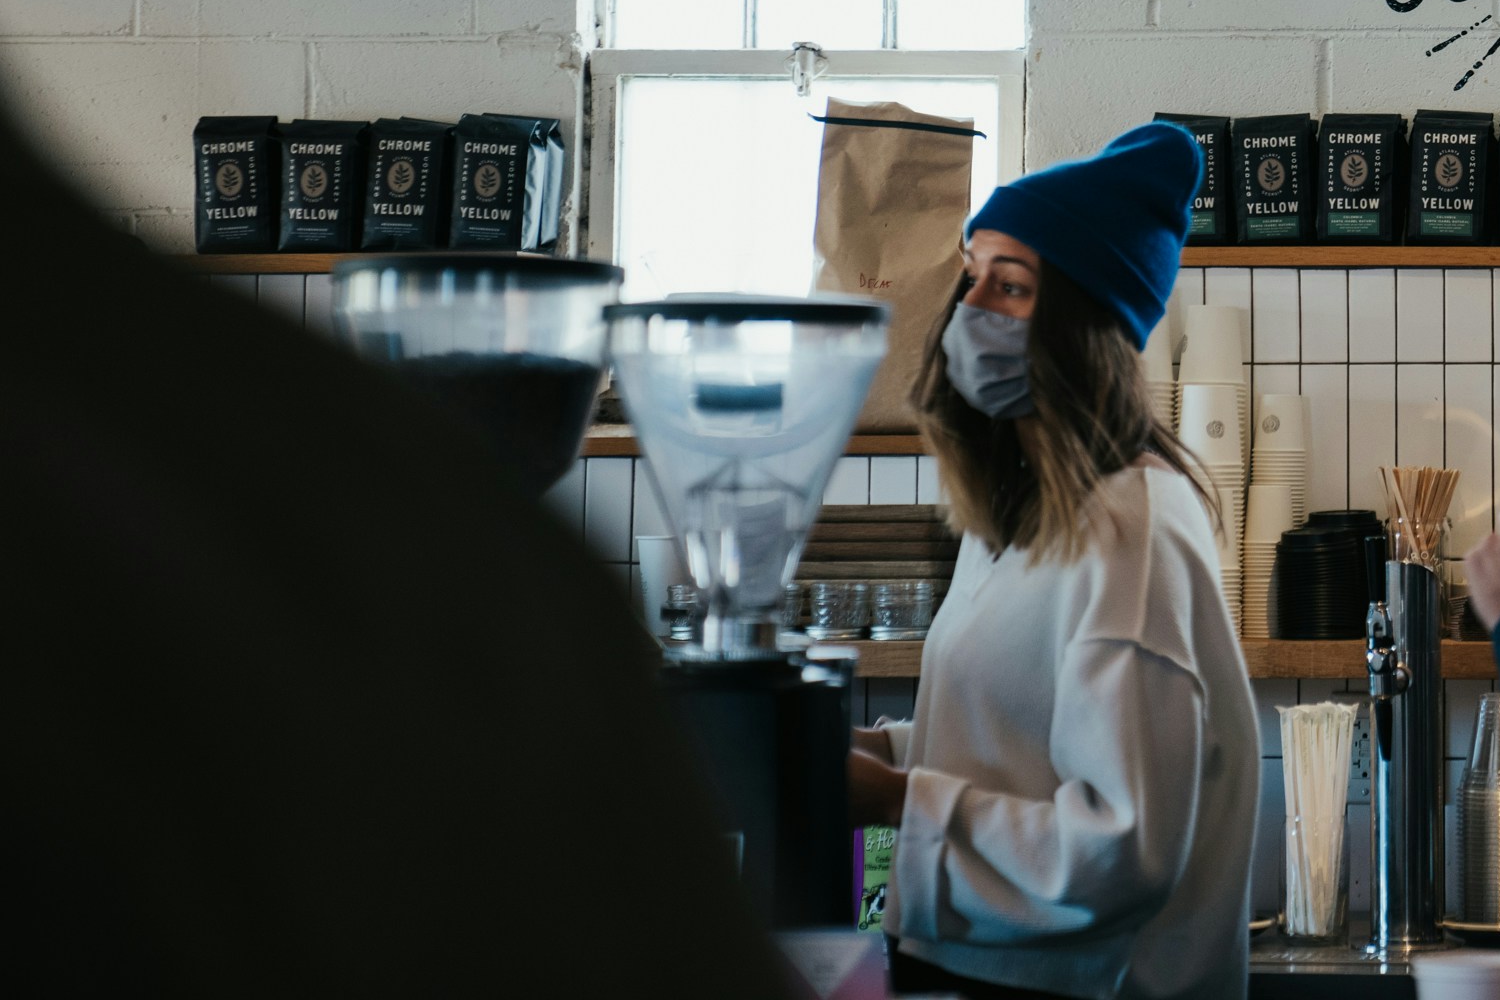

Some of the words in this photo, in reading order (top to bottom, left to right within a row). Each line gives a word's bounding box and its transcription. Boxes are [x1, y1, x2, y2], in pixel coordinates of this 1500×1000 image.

[1244, 136, 1296, 148] CHROME
[1329, 133, 1382, 144] CHROME
[1424, 133, 1477, 144] CHROME
[202, 141, 255, 154] CHROME
[290, 143, 343, 155] CHROME
[379, 140, 432, 151] CHROME
[464, 142, 517, 155] CHROME
[1244, 154, 1252, 197] TRADING
[373, 203, 424, 216] YELLOW
[1246, 201, 1299, 214] YELLOW
[1328, 198, 1380, 209] YELLOW
[1422, 198, 1474, 210] YELLOW
[206, 206, 258, 220] YELLOW
[288, 208, 338, 220] YELLOW
[460, 207, 511, 220] YELLOW
